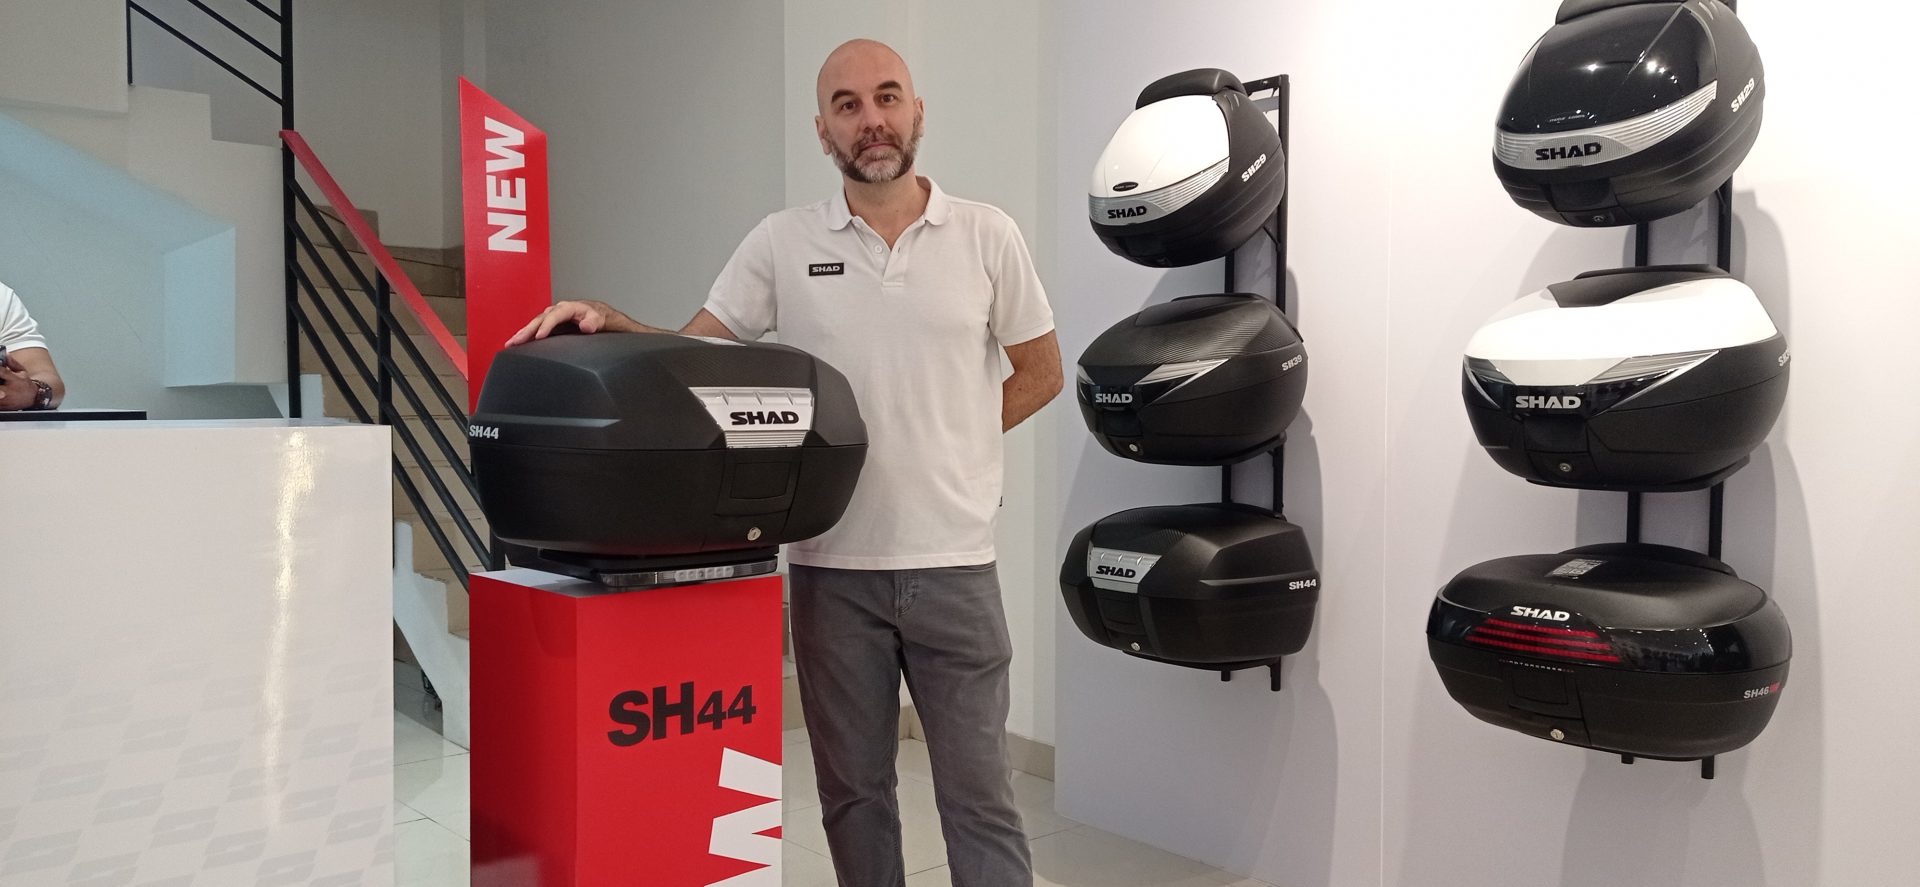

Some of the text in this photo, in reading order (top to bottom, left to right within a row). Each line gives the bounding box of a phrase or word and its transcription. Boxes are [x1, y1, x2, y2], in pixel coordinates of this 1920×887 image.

[1731, 77, 1755, 113] SH29
[1536, 142, 1602, 161] SHAD
[1241, 153, 1267, 182] SH29
[485, 117, 527, 253] NEW
[1107, 205, 1147, 219] SHAD
[1281, 354, 1303, 371] SH39
[1095, 393, 1133, 404] SHAD
[1515, 395, 1582, 410] SHAD
[731, 410, 800, 426] SHAD
[469, 424, 500, 440] SH44
[1096, 565, 1136, 578] SHAD
[1288, 578, 1317, 591] SH44
[1510, 605, 1571, 622] SHAD
[607, 681, 757, 747] SH44
